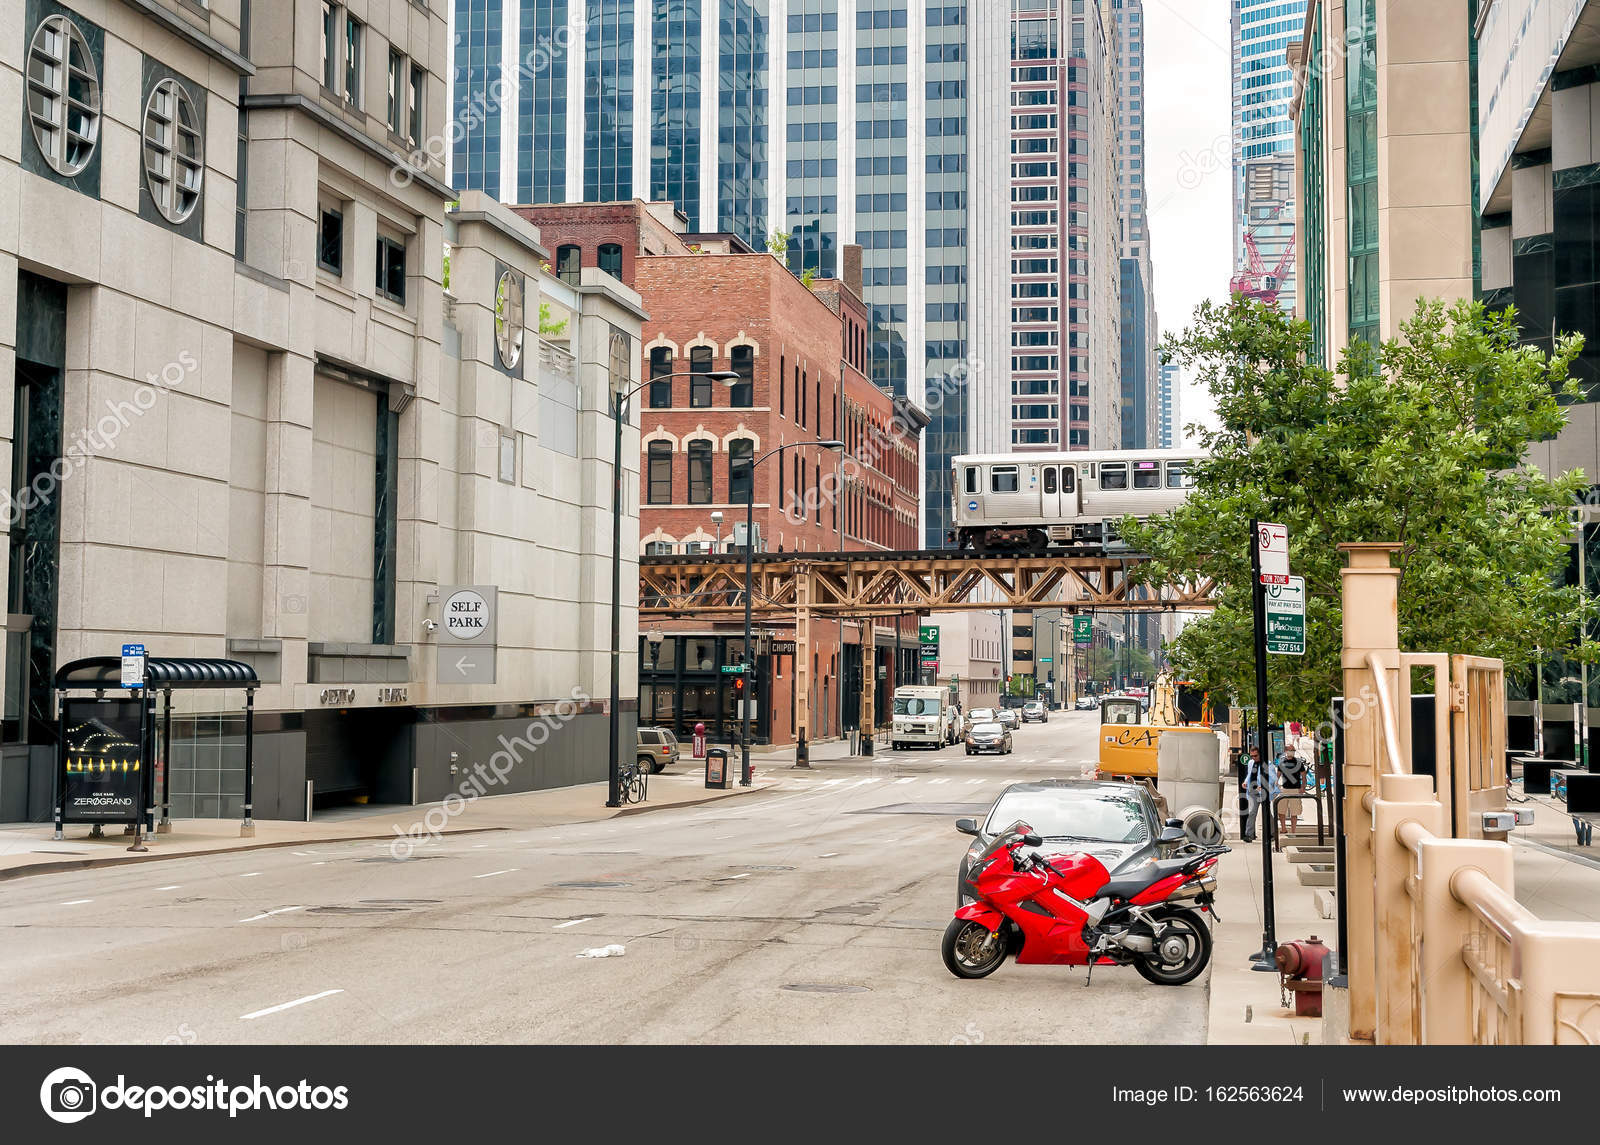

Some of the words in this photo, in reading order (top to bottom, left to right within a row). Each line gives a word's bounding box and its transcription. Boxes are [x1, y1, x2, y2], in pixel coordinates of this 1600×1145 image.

[1274, 576, 1286, 584] ZONE
[451, 602, 481, 612] SELF
[449, 617, 483, 627] PARK
[1277, 643, 1288, 651] 527
[1290, 644, 1301, 652] 514
